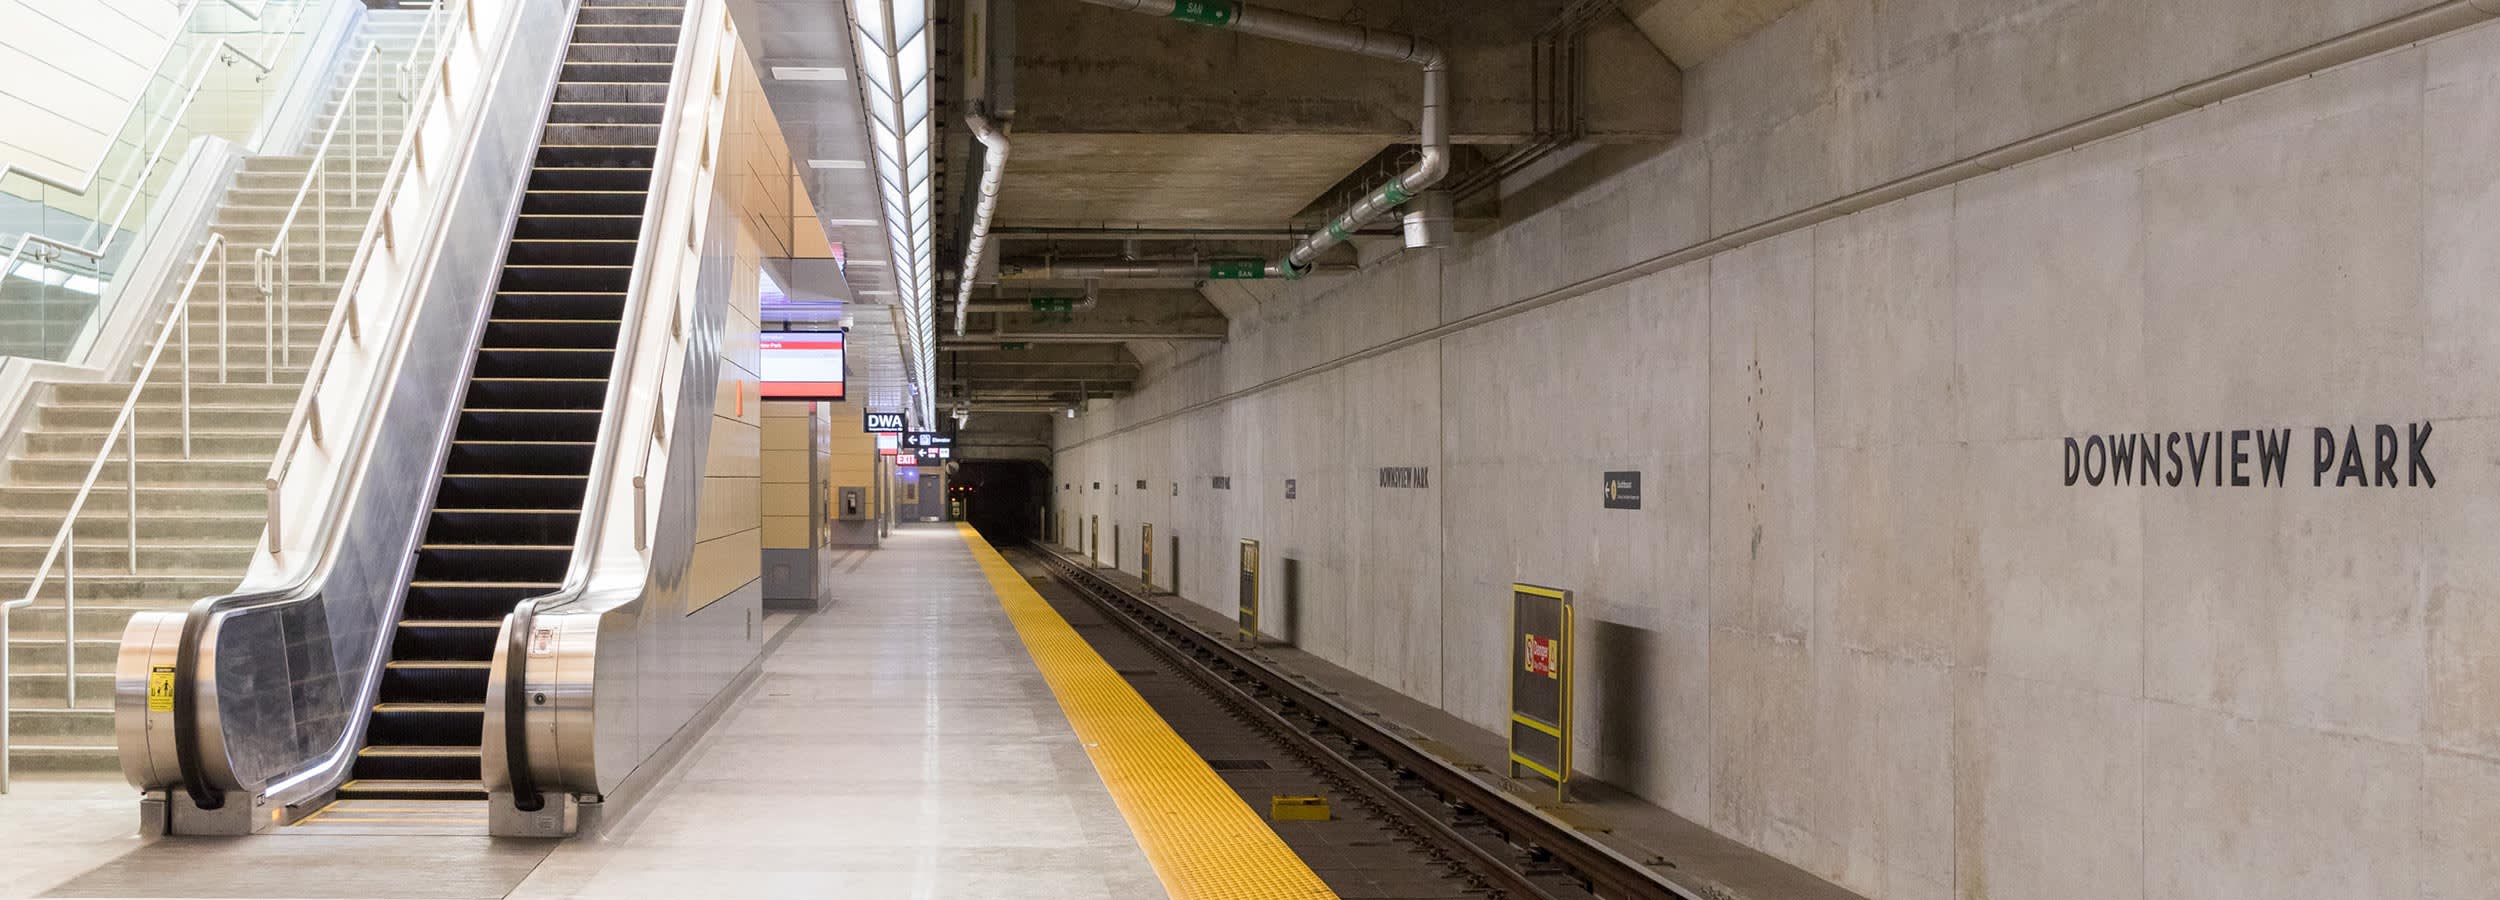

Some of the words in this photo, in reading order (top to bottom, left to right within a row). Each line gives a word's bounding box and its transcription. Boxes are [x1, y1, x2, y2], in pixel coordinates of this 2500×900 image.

[868, 414, 903, 428] DWA
[898, 454, 915, 465] EXIT
[2064, 428, 2291, 489] DOWNSVIEW
[2313, 421, 2436, 489] PARK
[1413, 466, 1429, 488] PARK
